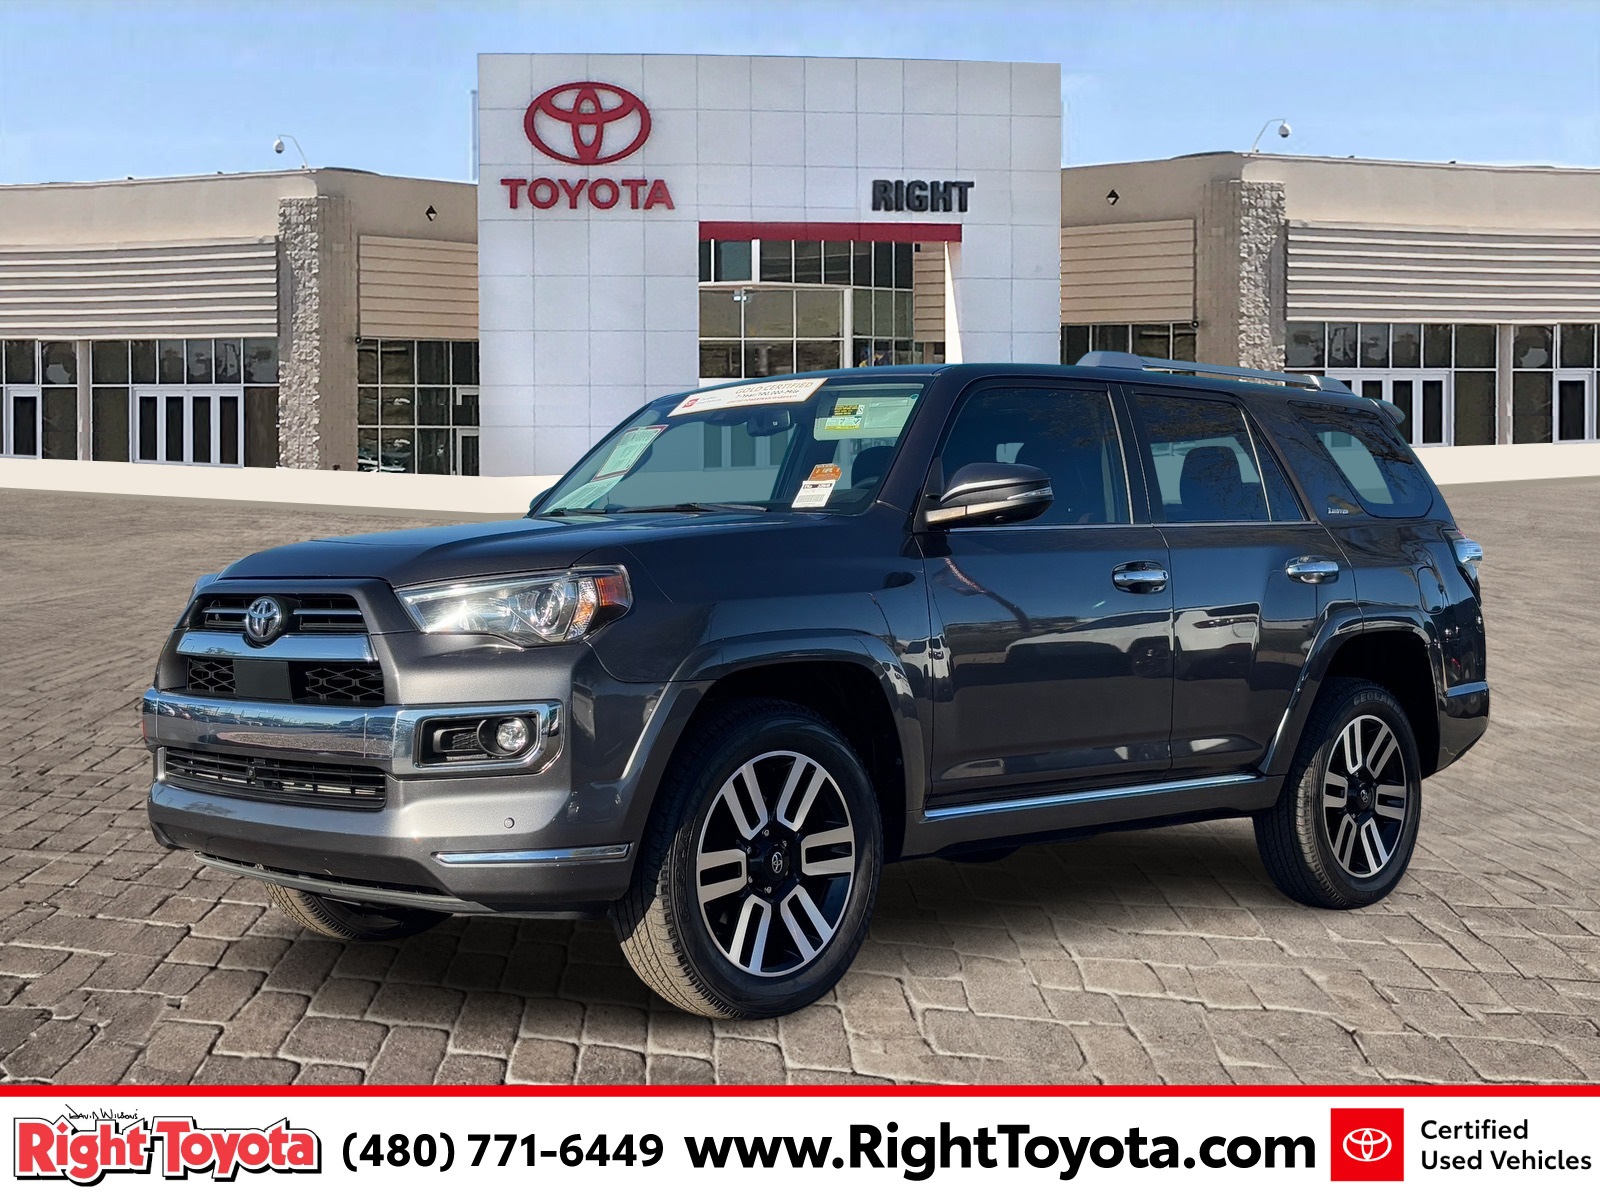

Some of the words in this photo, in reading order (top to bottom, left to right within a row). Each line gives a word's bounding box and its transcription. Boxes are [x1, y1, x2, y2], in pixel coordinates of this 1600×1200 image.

[500, 179, 675, 210] TOYOTA
[872, 180, 975, 212] RIGHT
[735, 385, 763, 394] GOLD
[763, 381, 814, 391] CERTIFIED
